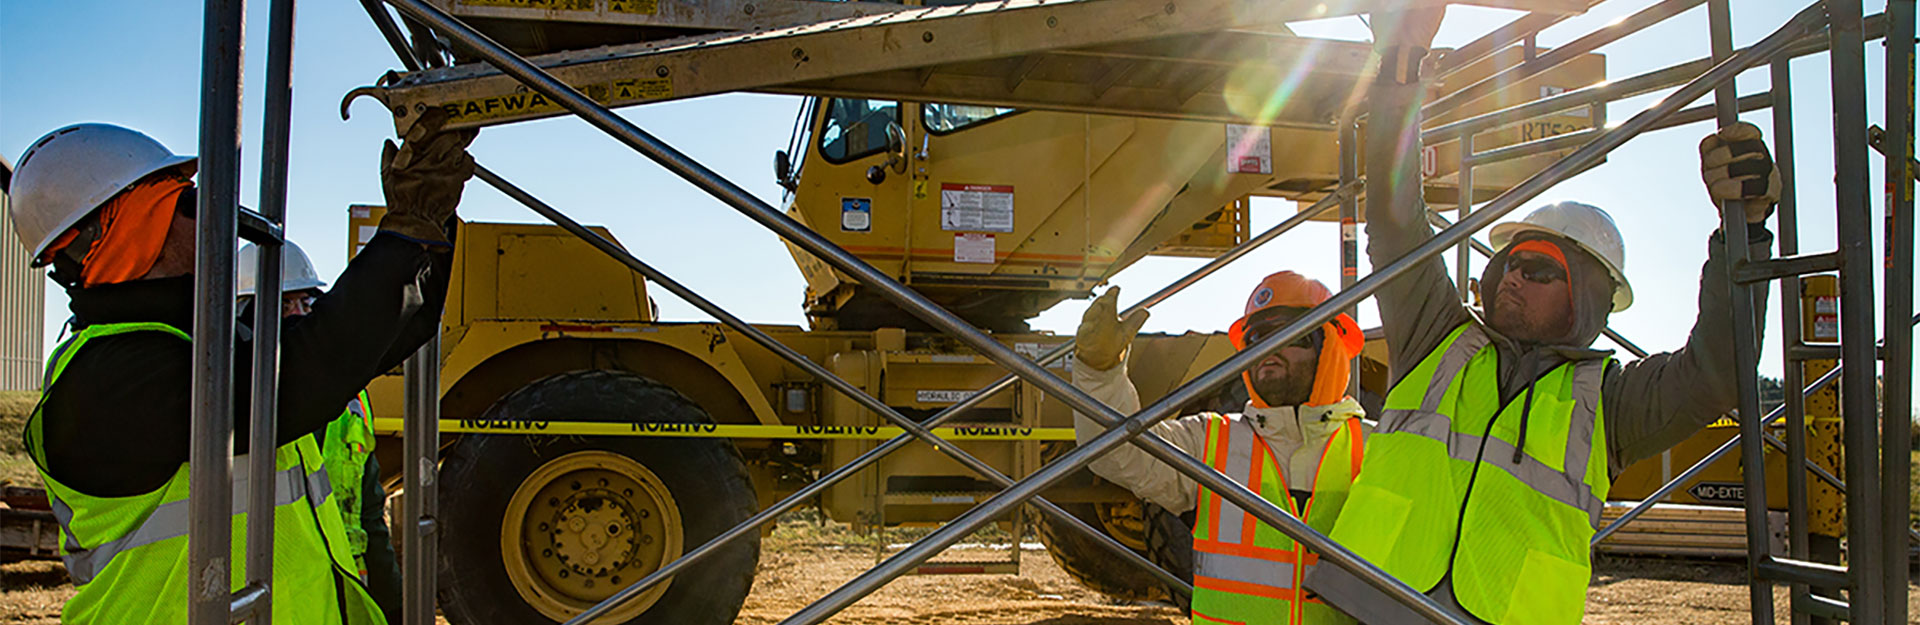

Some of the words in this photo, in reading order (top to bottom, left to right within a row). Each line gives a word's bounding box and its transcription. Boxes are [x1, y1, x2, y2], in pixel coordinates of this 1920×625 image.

[442, 94, 548, 118] SAFWA
[1422, 146, 1437, 176] 0
[1697, 486, 1744, 499] MID-EXTE
